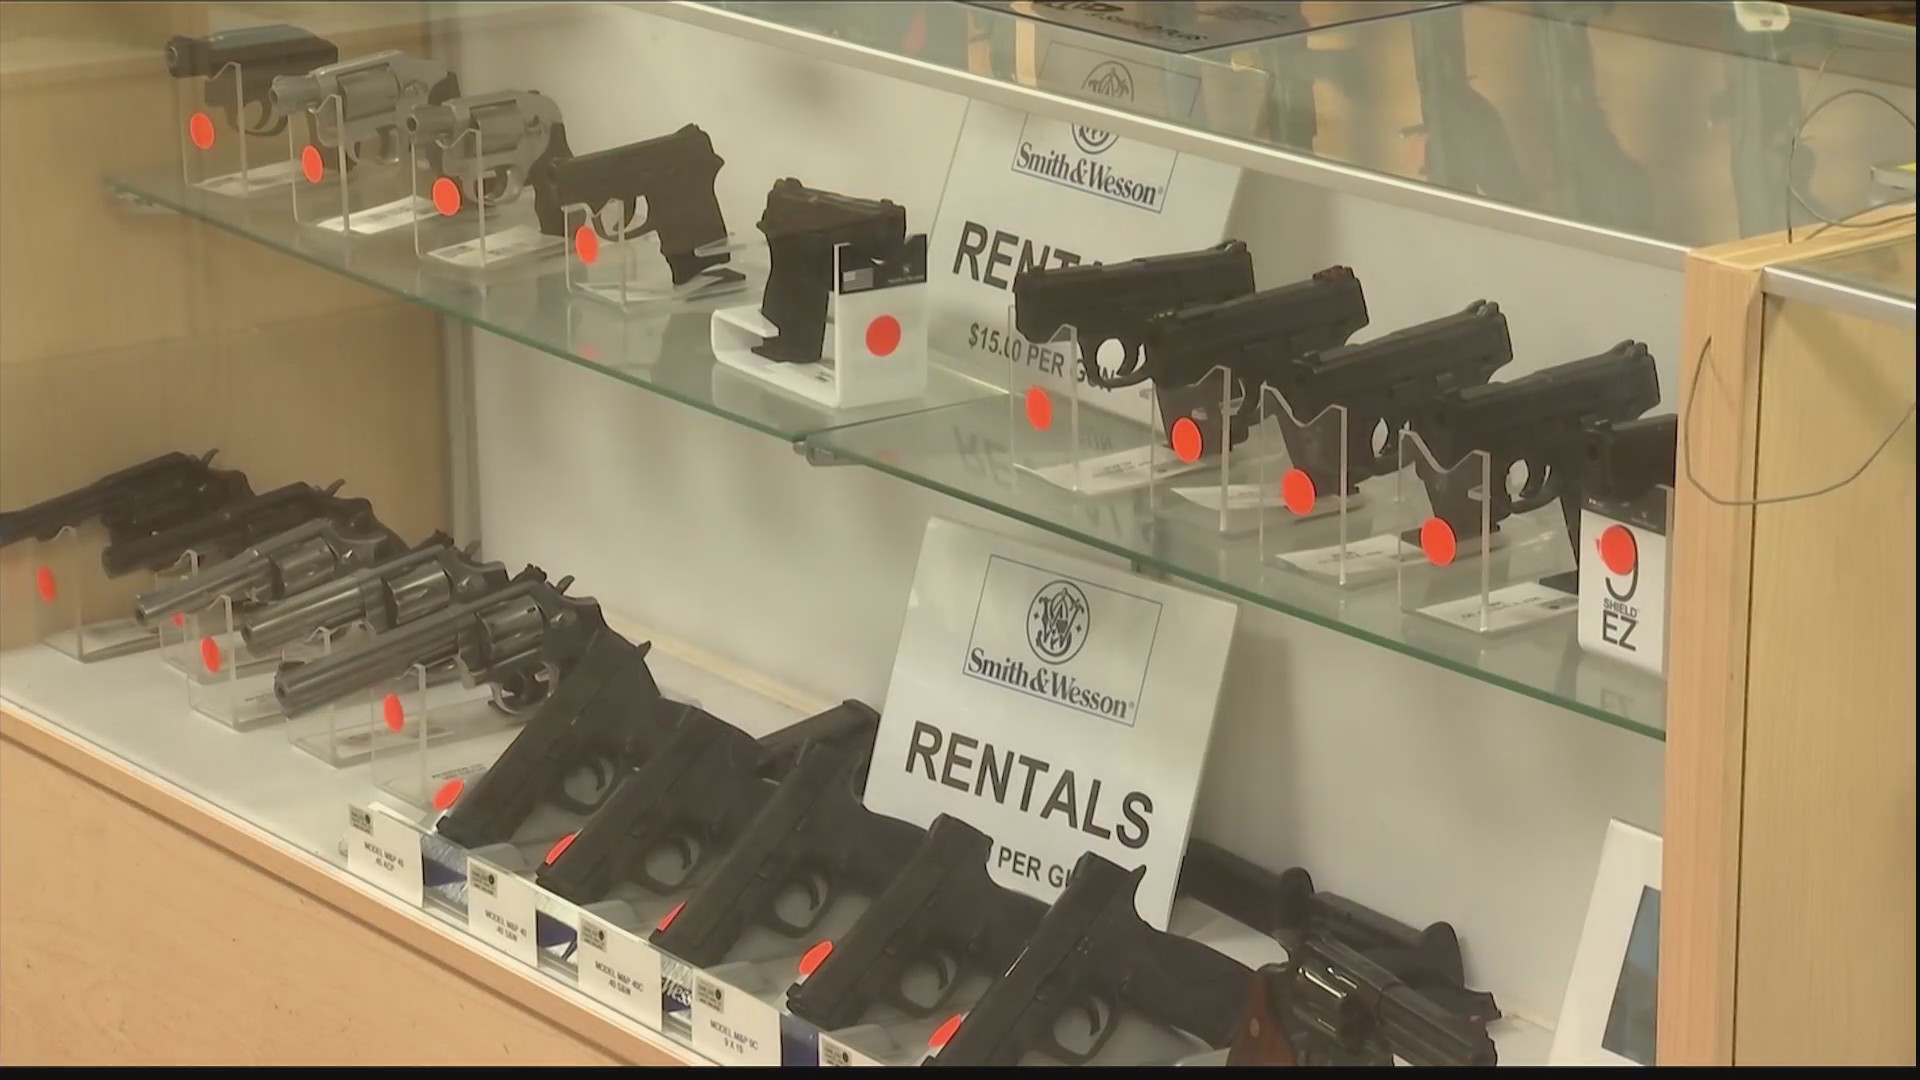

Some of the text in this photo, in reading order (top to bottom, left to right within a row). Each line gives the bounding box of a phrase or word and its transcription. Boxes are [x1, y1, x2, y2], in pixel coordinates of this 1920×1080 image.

[1026, 343, 1065, 378] PER
[1603, 597, 1637, 618] SHIELD
[1602, 609, 1637, 652] EZ
[905, 719, 1154, 850] RENTALS
[998, 845, 1042, 882] PER
[485, 908, 505, 927] MODEL
[595, 959, 616, 979] MODEL
[709, 1018, 732, 1039] MODEL
